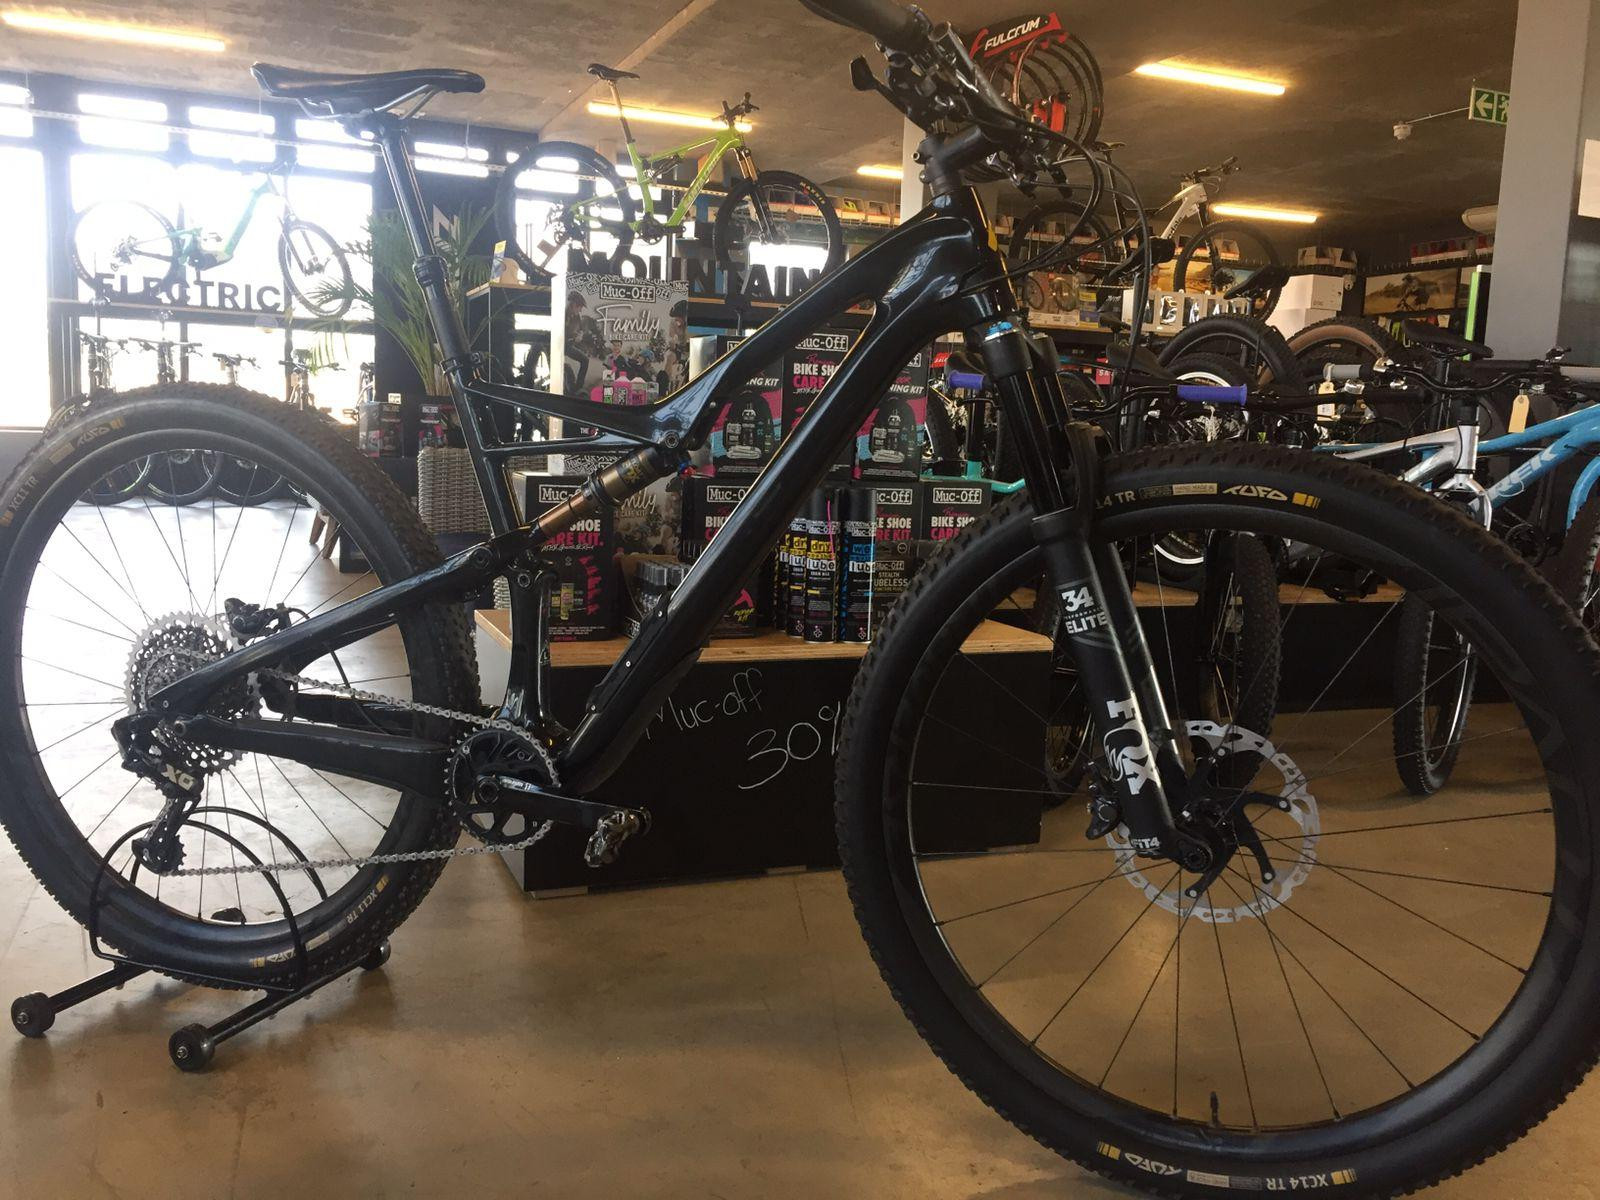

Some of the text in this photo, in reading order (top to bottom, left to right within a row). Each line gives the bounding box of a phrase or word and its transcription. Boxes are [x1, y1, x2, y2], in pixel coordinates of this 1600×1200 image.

[603, 284, 653, 300] Muc-Off
[596, 303, 660, 337] Family
[793, 363, 819, 375] BIKE
[764, 378, 779, 387] KIT
[910, 385, 924, 394] KIT
[541, 487, 581, 501] Muc-
[709, 488, 746, 501] Muc-O
[877, 490, 911, 503] c-Off
[935, 490, 980, 502] Muc-Off
[1115, 490, 1135, 504] TR
[705, 516, 729, 528] BIK
[886, 518, 912, 529] SHOE
[931, 516, 952, 528] BIKE
[807, 559, 835, 572] lube
[874, 578, 908, 588] UBELESS
[1061, 587, 1094, 612] 34
[1065, 611, 1108, 634] ELITE
[1265, 1177, 1287, 1191] TR
[1290, 1173, 1329, 1191] XC14
